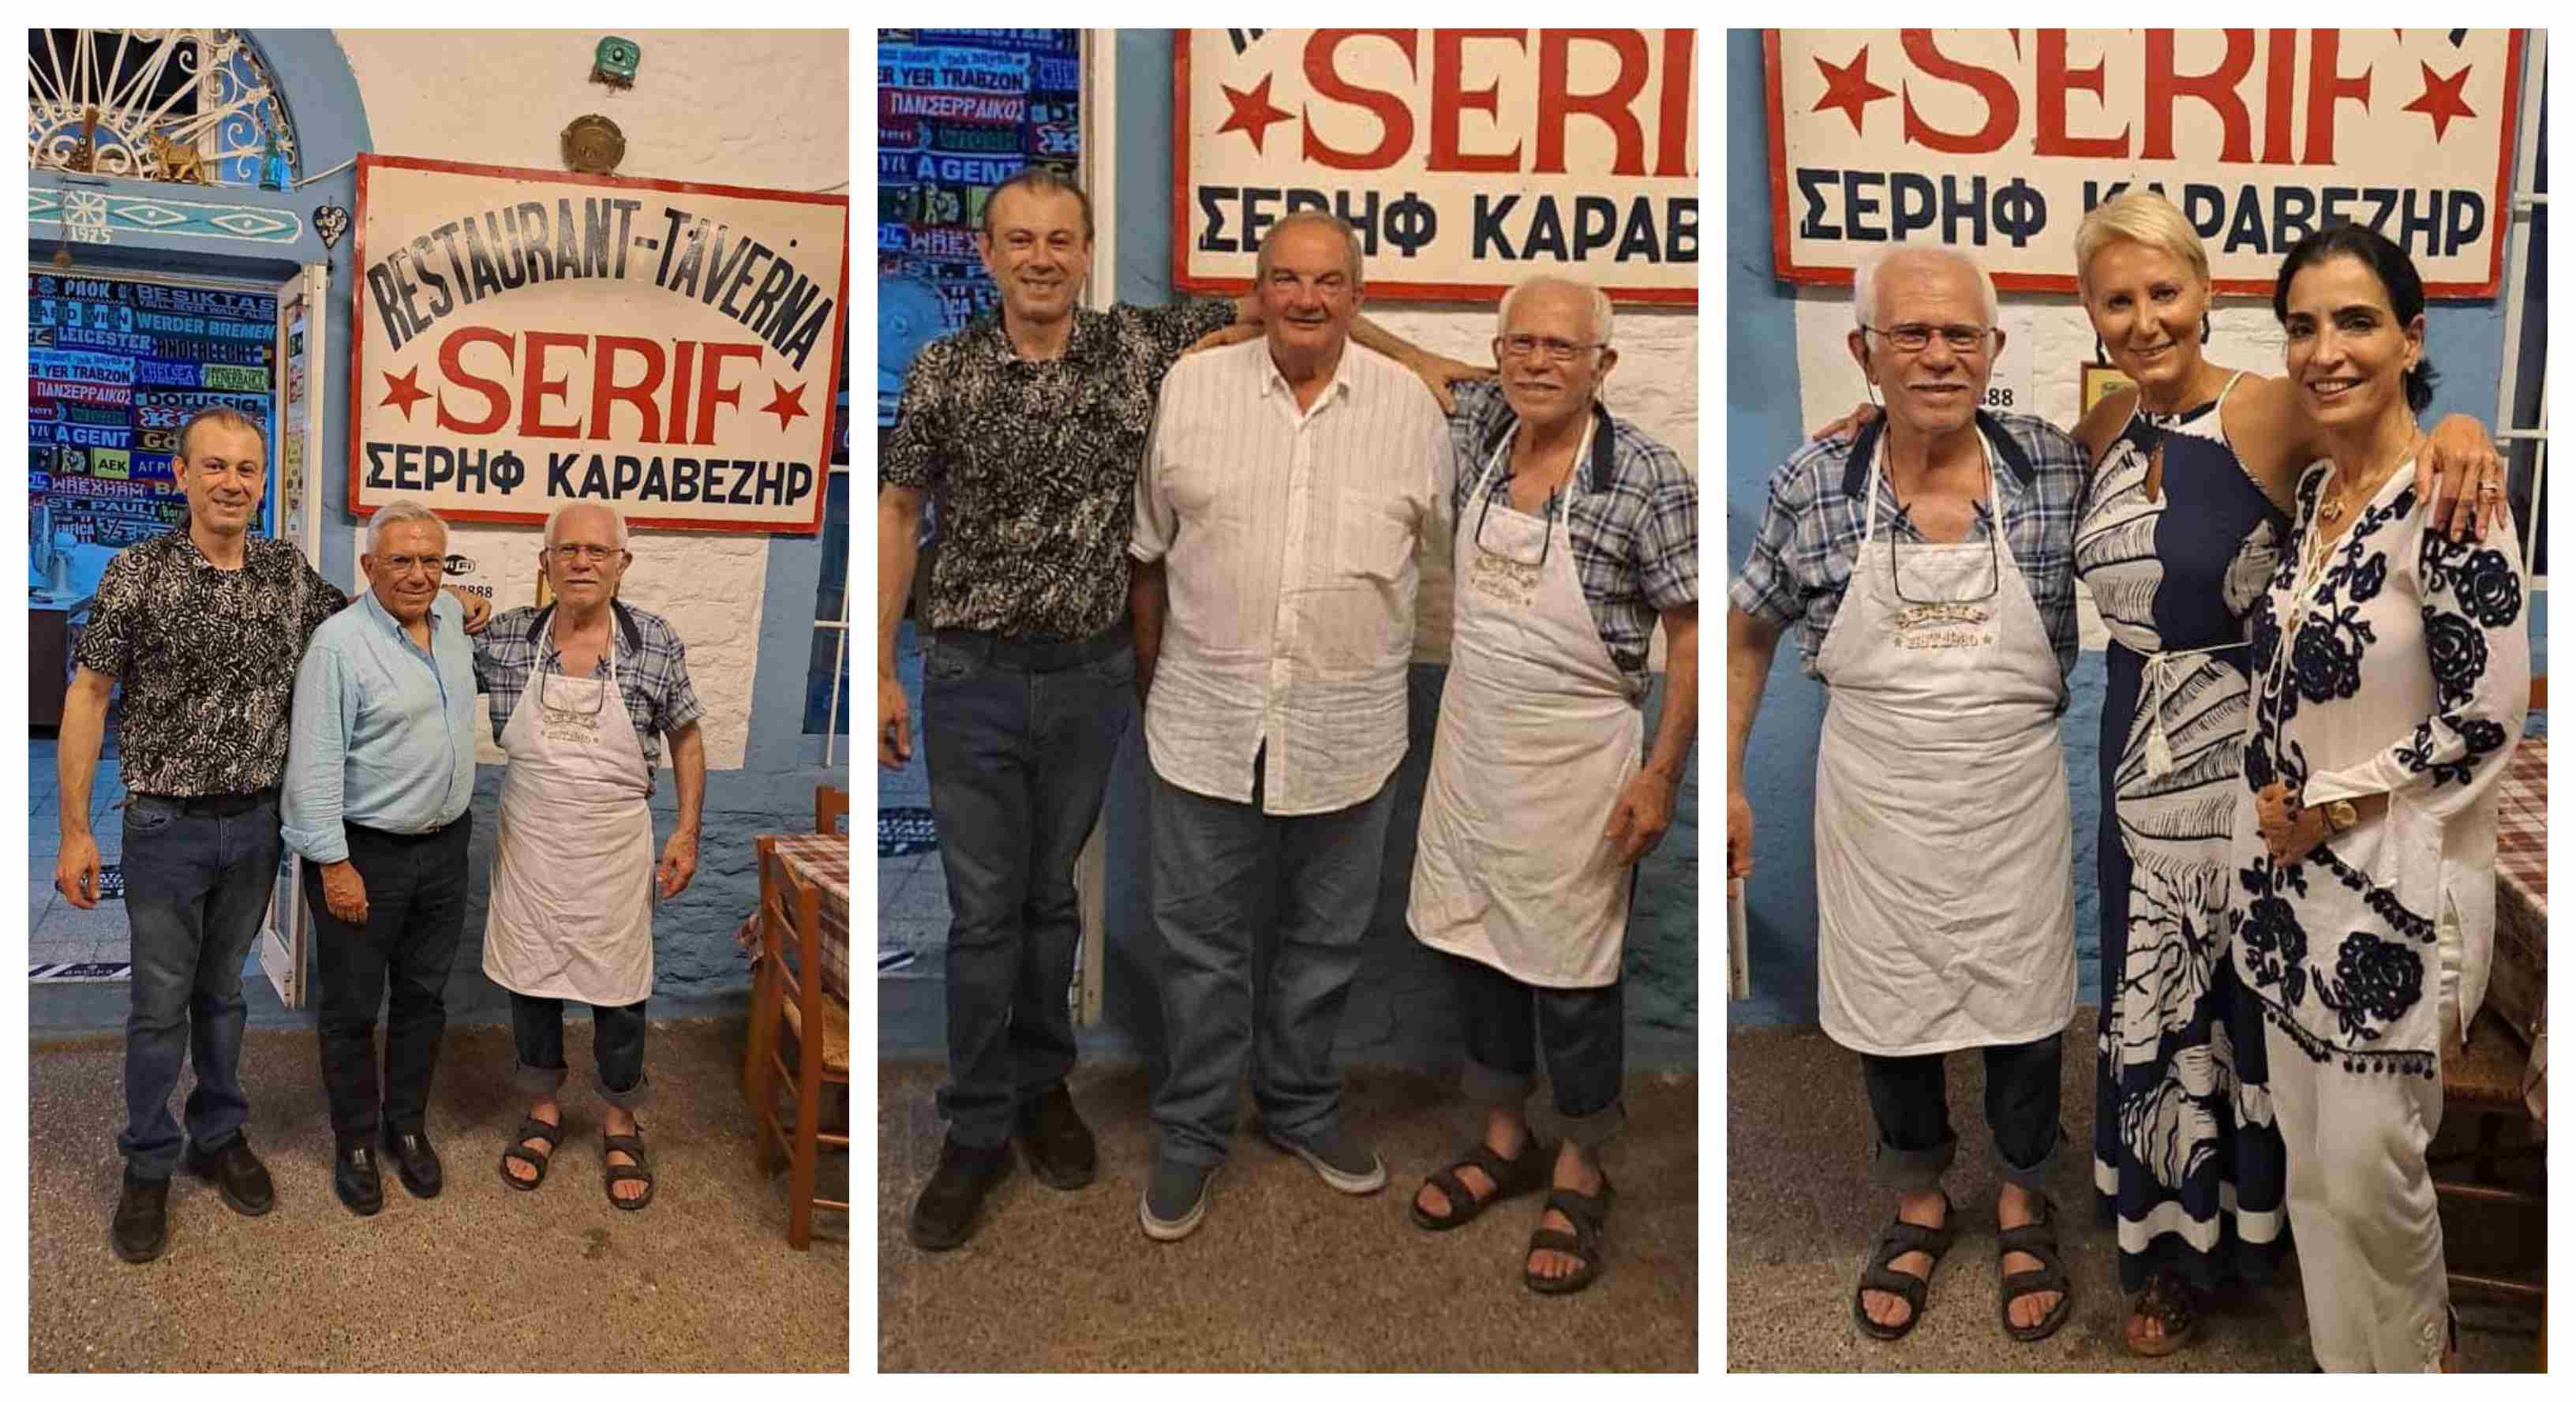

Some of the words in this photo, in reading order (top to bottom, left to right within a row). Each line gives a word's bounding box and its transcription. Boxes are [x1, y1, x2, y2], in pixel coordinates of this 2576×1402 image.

[1303, 28, 1698, 177] SERI
[1899, 28, 2372, 165] SERIF
[1472, 193, 1698, 264] ΚΑΡΑΒ
[1796, 168, 2046, 246] ΣΕΡΗΦ
[2084, 182, 2485, 257] ΡΑΒΕΖΗΡ
[64, 279, 110, 298] PAOK
[58, 326, 152, 350] LEICESTER
[136, 311, 205, 335] WERDER
[208, 320, 275, 341] BREMEN
[73, 365, 130, 384] TRABZON
[436, 326, 763, 445] SERIF
[365, 442, 526, 495] ΣΕΡΗΦ
[547, 452, 813, 506] ΚΑΡΑΒΕΖΗΡ
[90, 499, 156, 515] PAULI
